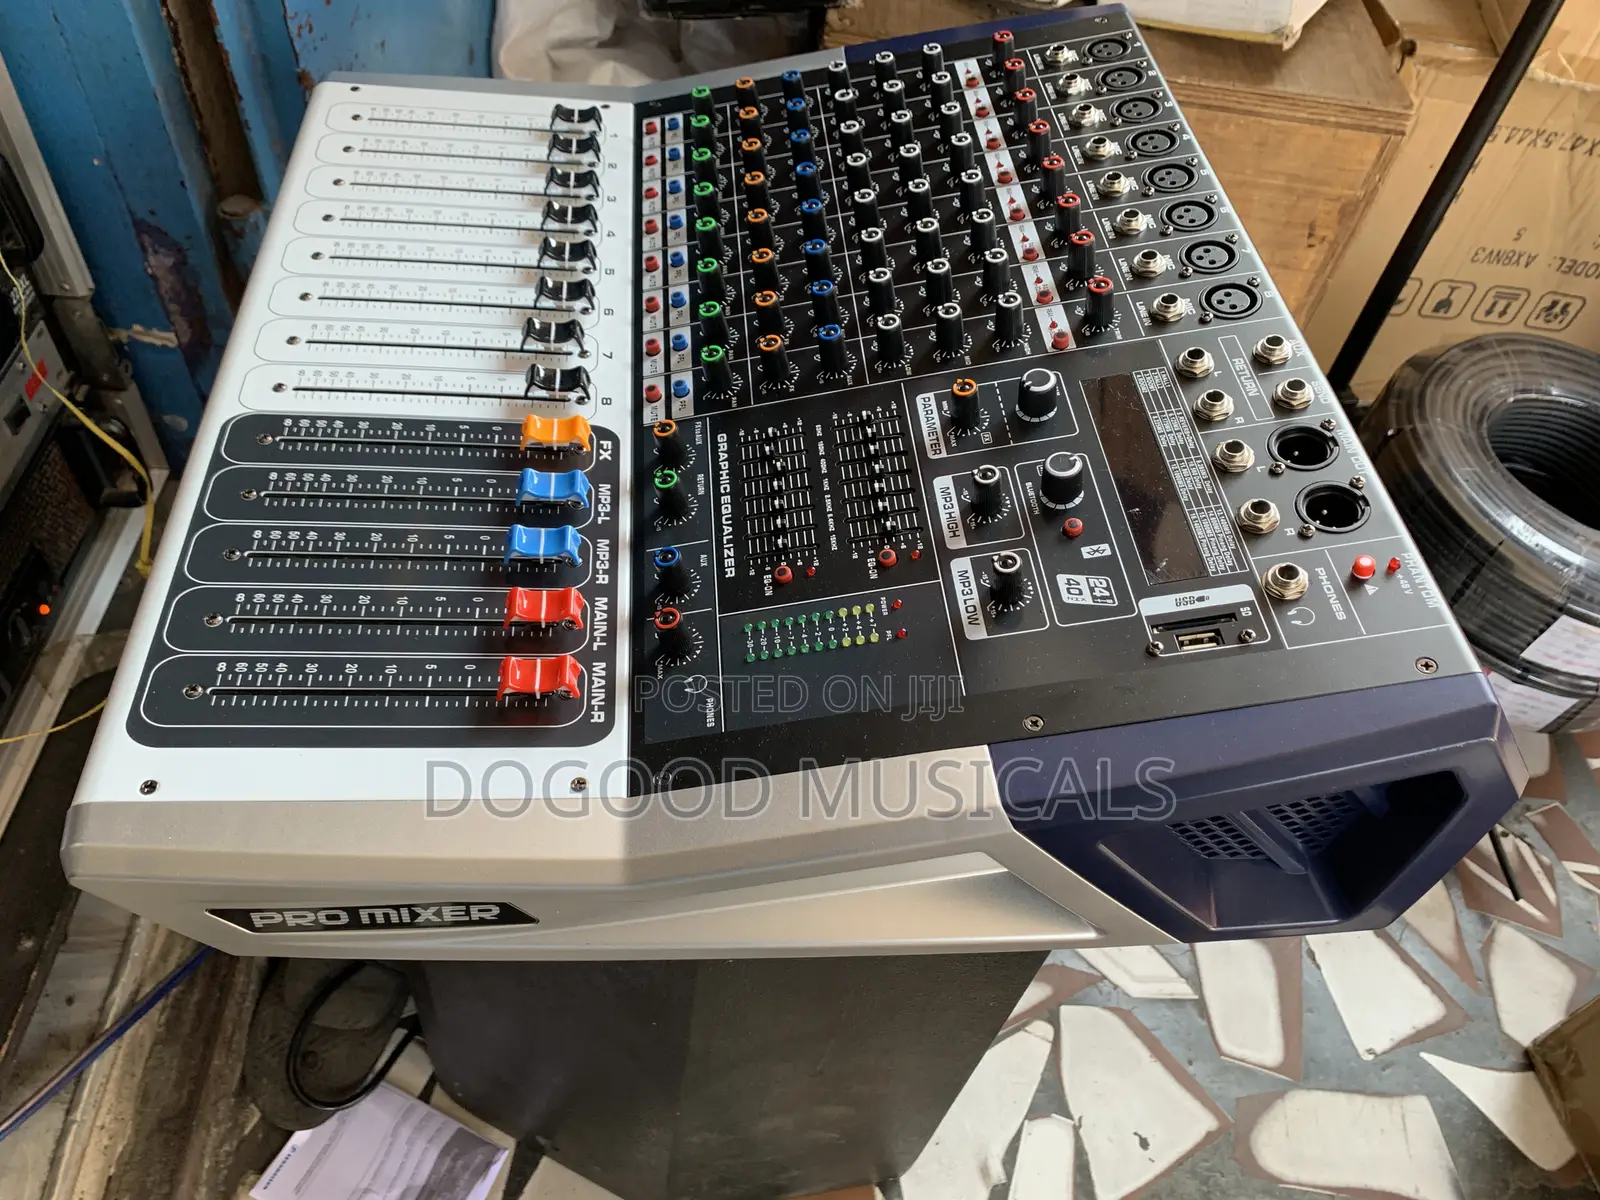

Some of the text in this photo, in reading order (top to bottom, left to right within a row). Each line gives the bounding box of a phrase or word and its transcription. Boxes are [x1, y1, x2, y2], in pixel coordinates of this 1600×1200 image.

[607, 196, 616, 204] 3
[606, 230, 616, 238] 4
[1163, 254, 1176, 271] MIC
[1470, 246, 1539, 268] AX8NV3
[605, 268, 615, 276] 5
[1185, 298, 1196, 315] MIC
[604, 308, 614, 317] 6
[1289, 338, 1305, 357] AUX
[602, 351, 613, 360] 7
[1232, 357, 1260, 397] RETURN
[1311, 380, 1330, 404] SEND
[601, 396, 612, 406] 8
[1234, 416, 1245, 424] R
[920, 396, 942, 456] PARAMETER
[599, 440, 612, 461] FX
[1336, 429, 1371, 475] MAIN OUT
[697, 474, 705, 495] RETURN
[597, 483, 611, 524] MP3-L
[1025, 482, 1040, 515] BLUETOOTH
[717, 433, 736, 578] GRAPHIC EQUALIZER
[939, 486, 961, 539] MP3 HIGH
[269, 530, 282, 539] 60
[287, 531, 300, 540] 50
[306, 531, 318, 540] 40
[334, 531, 346, 541] 30
[370, 532, 383, 541] 20
[1284, 527, 1295, 536] R
[407, 534, 419, 542] 10
[596, 538, 610, 584] MP3-R
[700, 554, 708, 567] AUX
[1401, 552, 1441, 609] PHANTOM
[1064, 578, 1084, 596] 40
[1088, 578, 1110, 599] 24
[252, 593, 266, 603] 60
[272, 594, 285, 603] 50
[291, 594, 304, 603] 40
[320, 595, 333, 604] 30
[358, 595, 371, 604] 20
[957, 569, 980, 626] MP3 LOW
[1315, 567, 1347, 621] PHONES
[396, 596, 408, 605] 10
[880, 596, 889, 616] POWER
[1240, 606, 1252, 617] SD
[592, 596, 608, 651] MAIN-L
[885, 630, 893, 641] PFL
[234, 662, 248, 672] 60
[255, 663, 268, 673] 50
[275, 663, 288, 673] 40
[305, 663, 318, 673] 30
[345, 663, 358, 674] 20
[385, 664, 398, 674] 10
[590, 661, 606, 724] MAIN-R
[706, 697, 715, 728] PHONES
[250, 904, 500, 928] PRO MIXER
